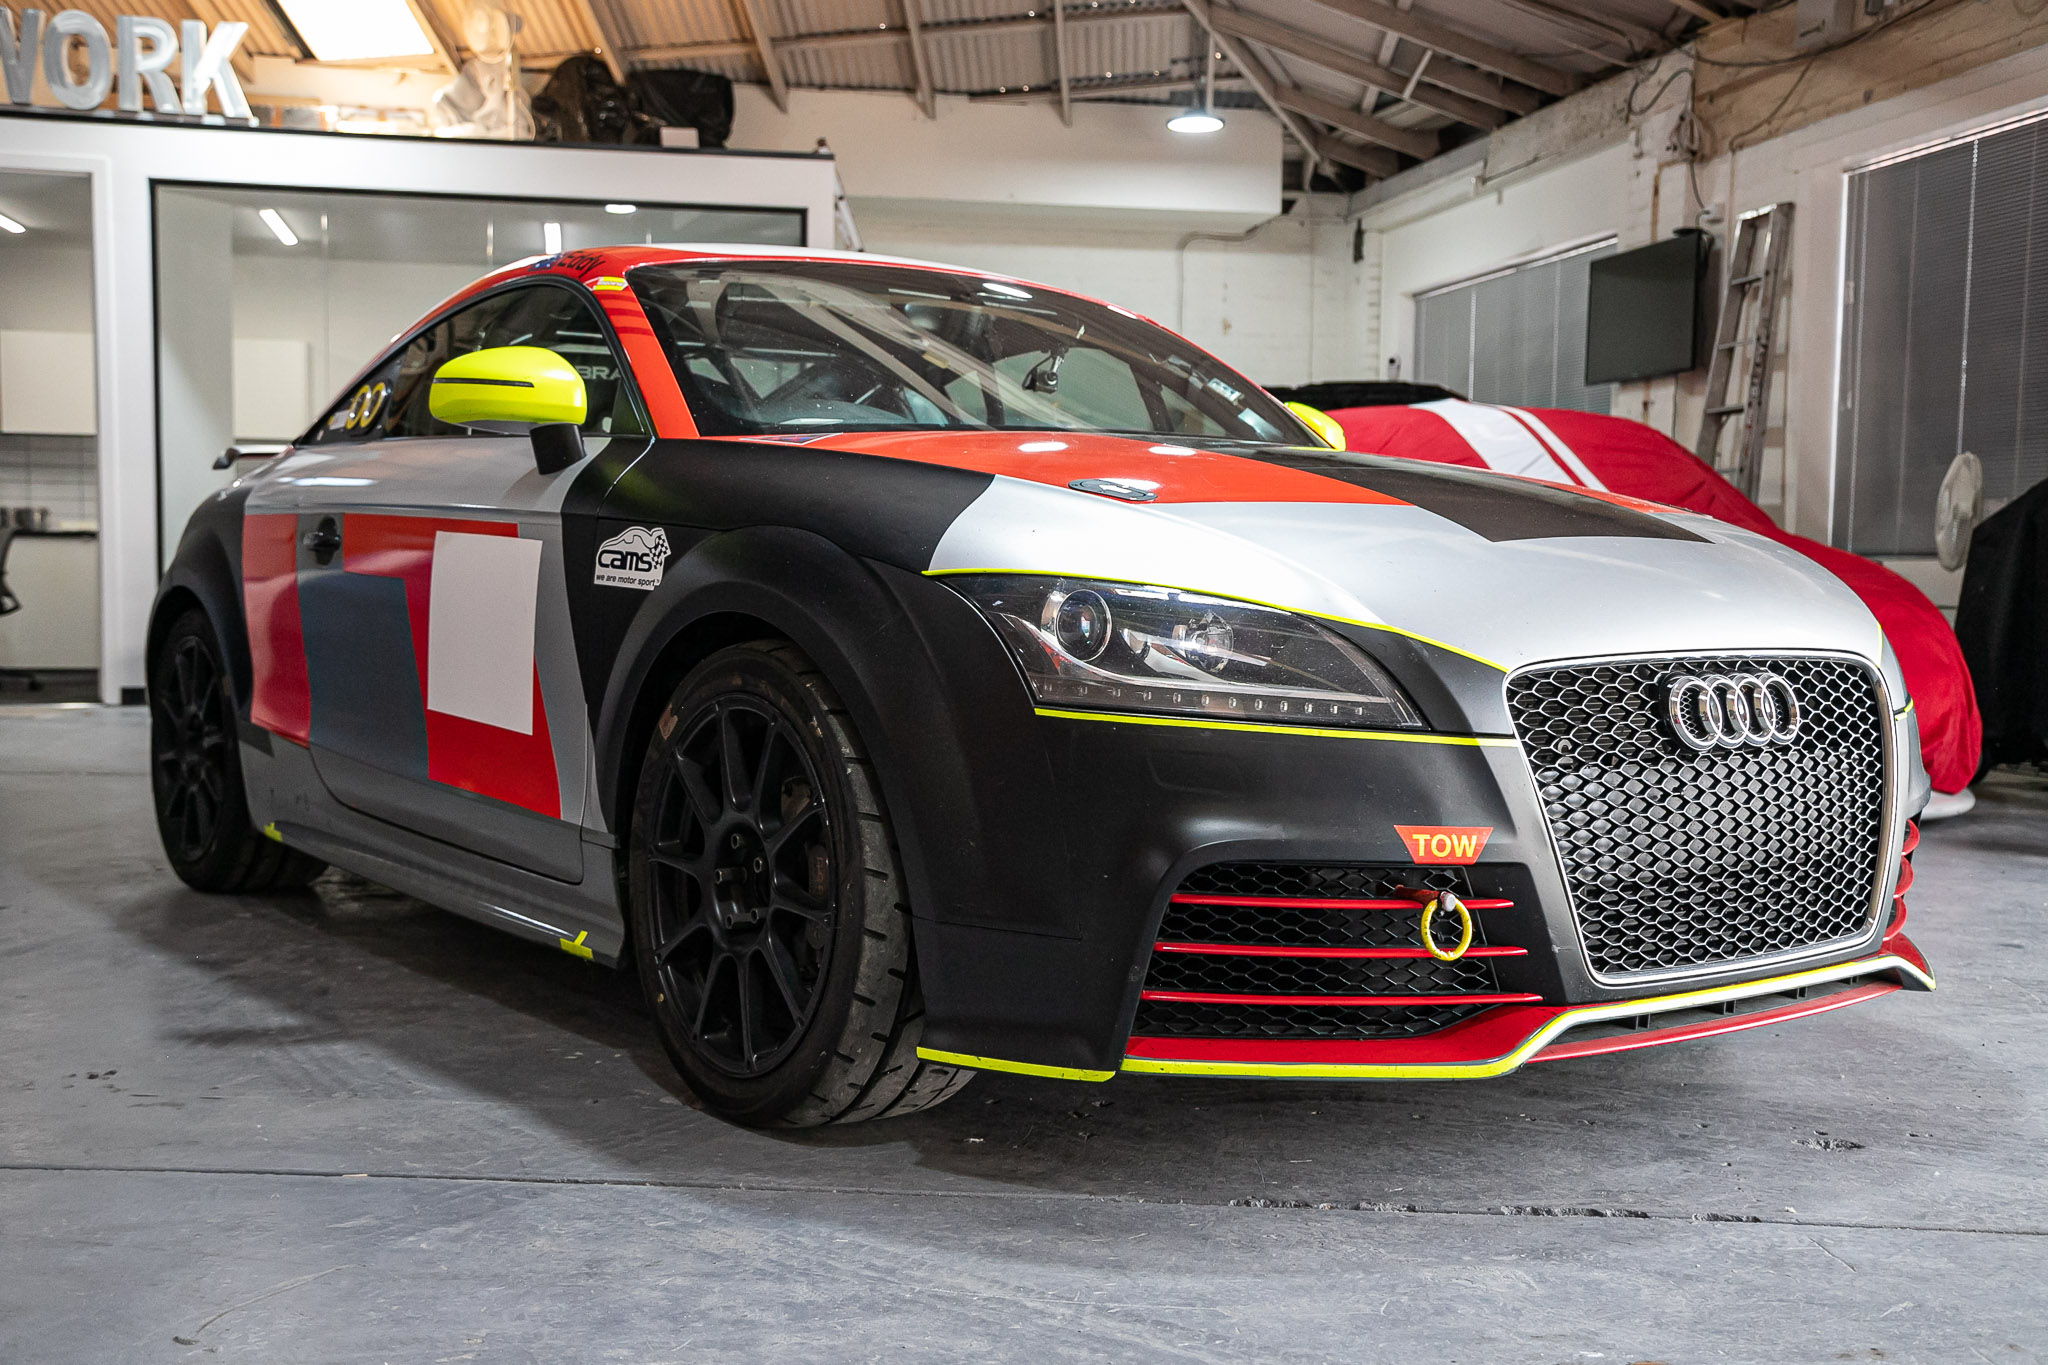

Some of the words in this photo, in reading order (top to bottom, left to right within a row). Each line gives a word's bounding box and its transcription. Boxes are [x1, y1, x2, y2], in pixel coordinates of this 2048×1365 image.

[606, 575, 617, 583] are
[618, 576, 637, 585] motor
[637, 578, 656, 587] sport
[1412, 833, 1478, 858] TOW
